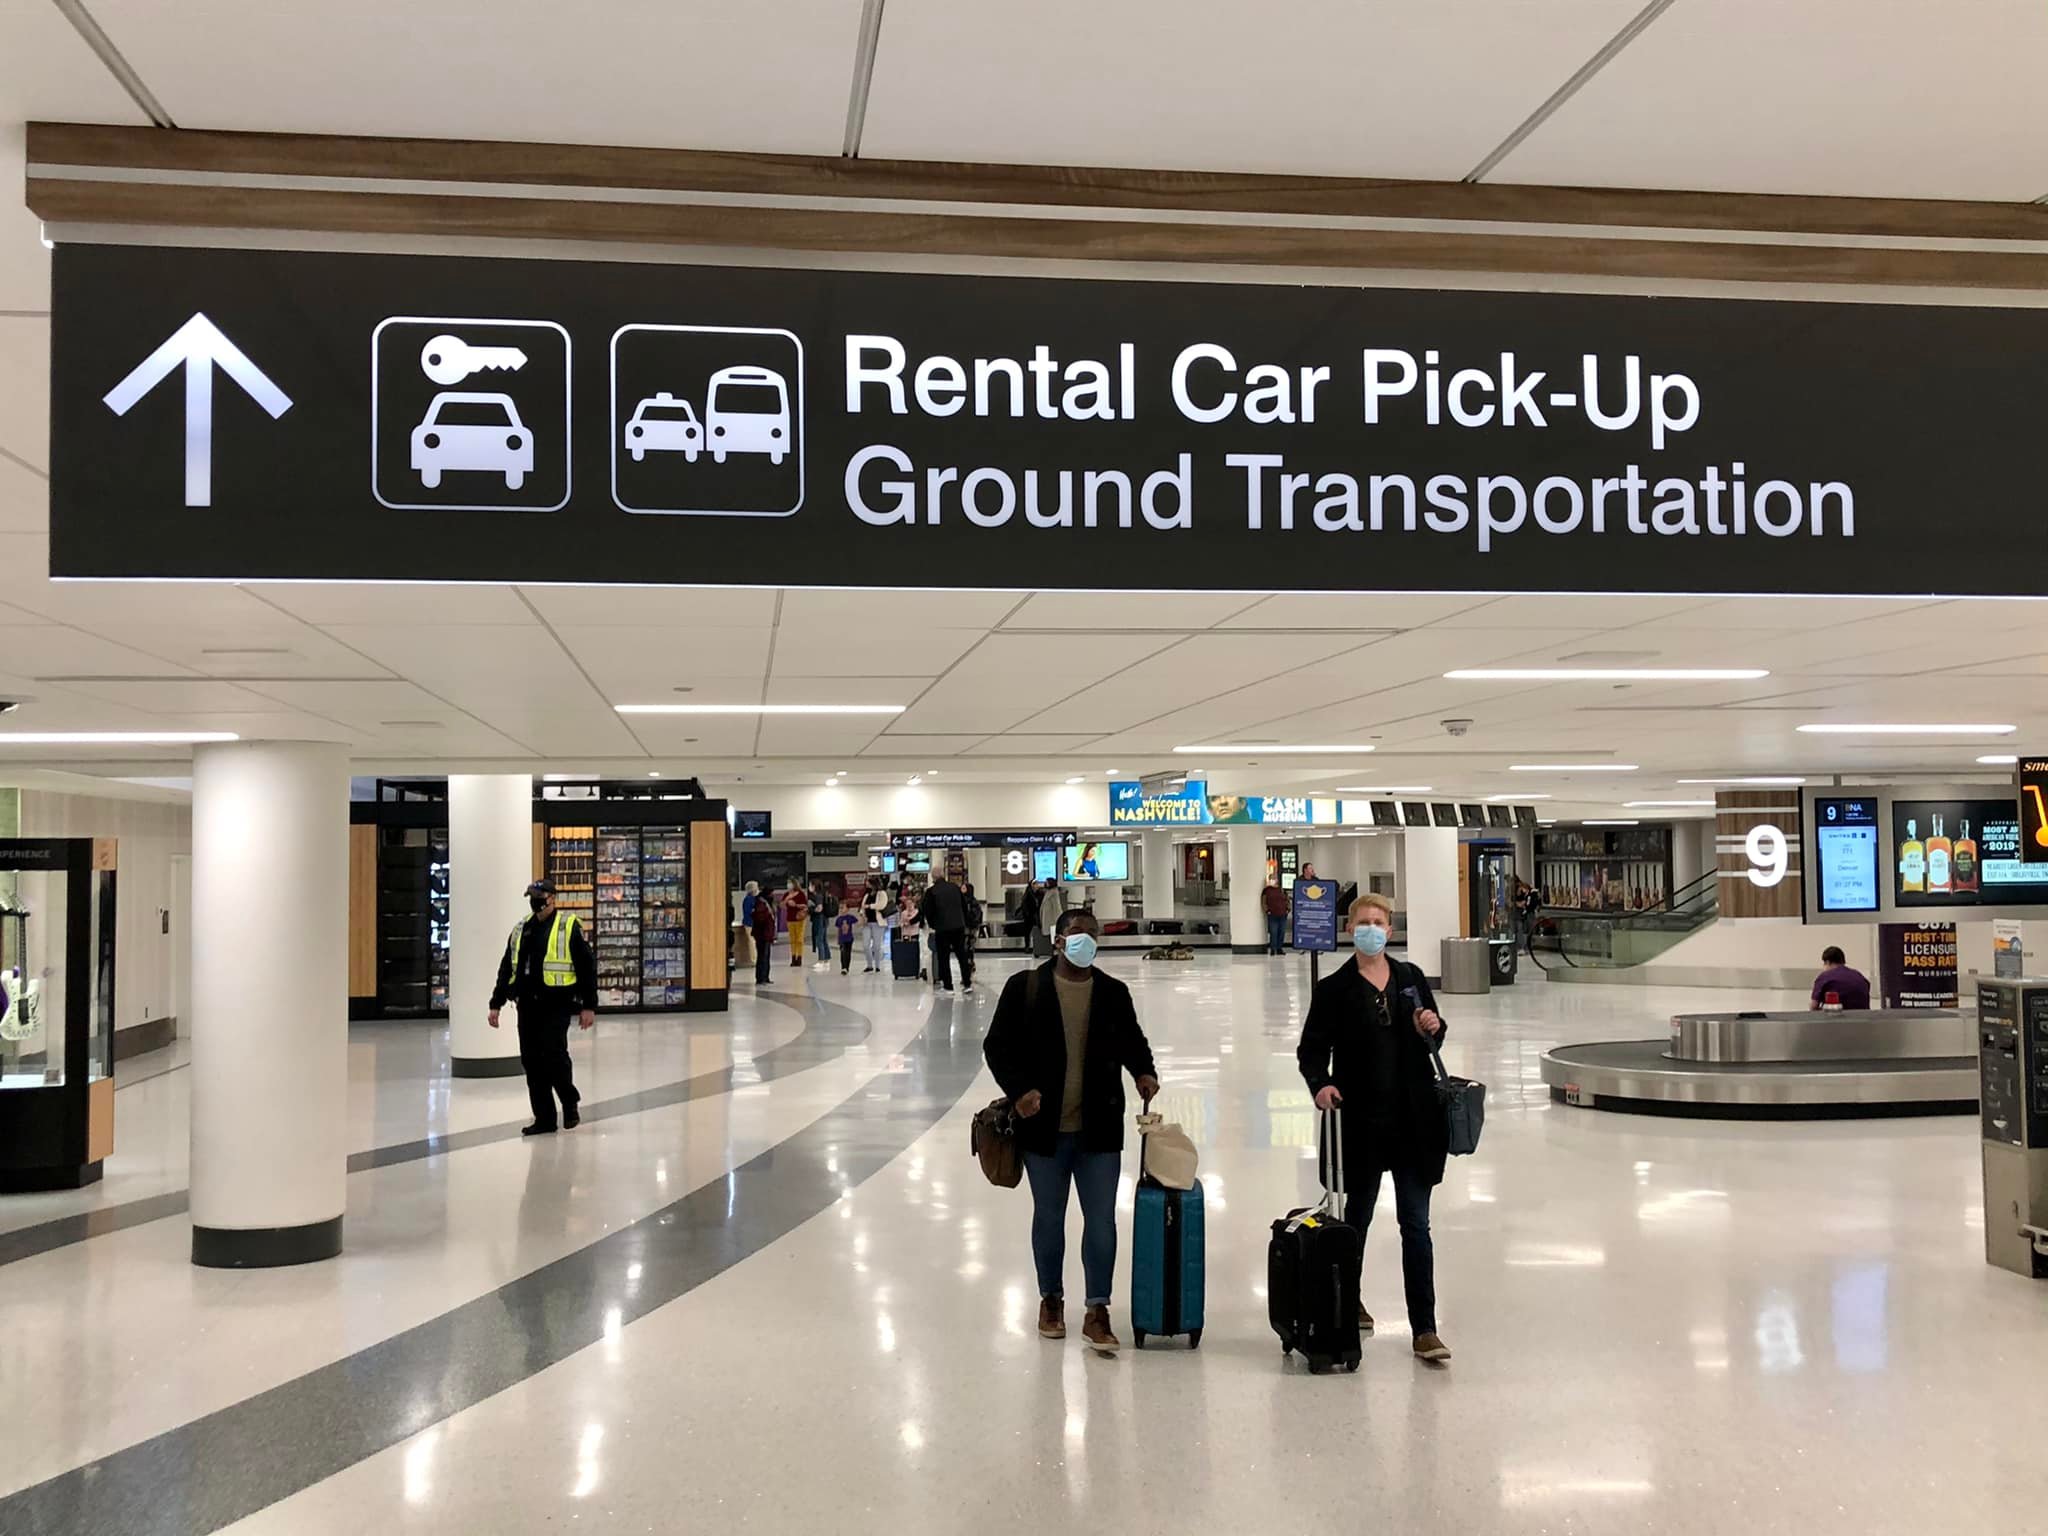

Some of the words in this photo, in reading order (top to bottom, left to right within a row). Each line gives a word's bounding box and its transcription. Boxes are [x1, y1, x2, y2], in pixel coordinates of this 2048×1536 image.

[844, 333, 1136, 424] Rental
[1170, 341, 1332, 425] Car
[1362, 347, 1701, 451] Pick-Up
[843, 443, 1193, 531] Ground
[1224, 452, 1855, 553] Transportation
[1142, 799, 1186, 808] WELCOME
[1188, 799, 1201, 808] TO
[1261, 797, 1306, 812] CASH
[1114, 808, 1201, 821] NASHVILLE!
[1263, 812, 1307, 822] MUSEUM
[1827, 806, 1837, 820] 9
[1988, 841, 2015, 851] 2019
[1006, 850, 1024, 875] 8
[1746, 824, 1788, 888] 9
[1903, 955, 1936, 967] PASS
